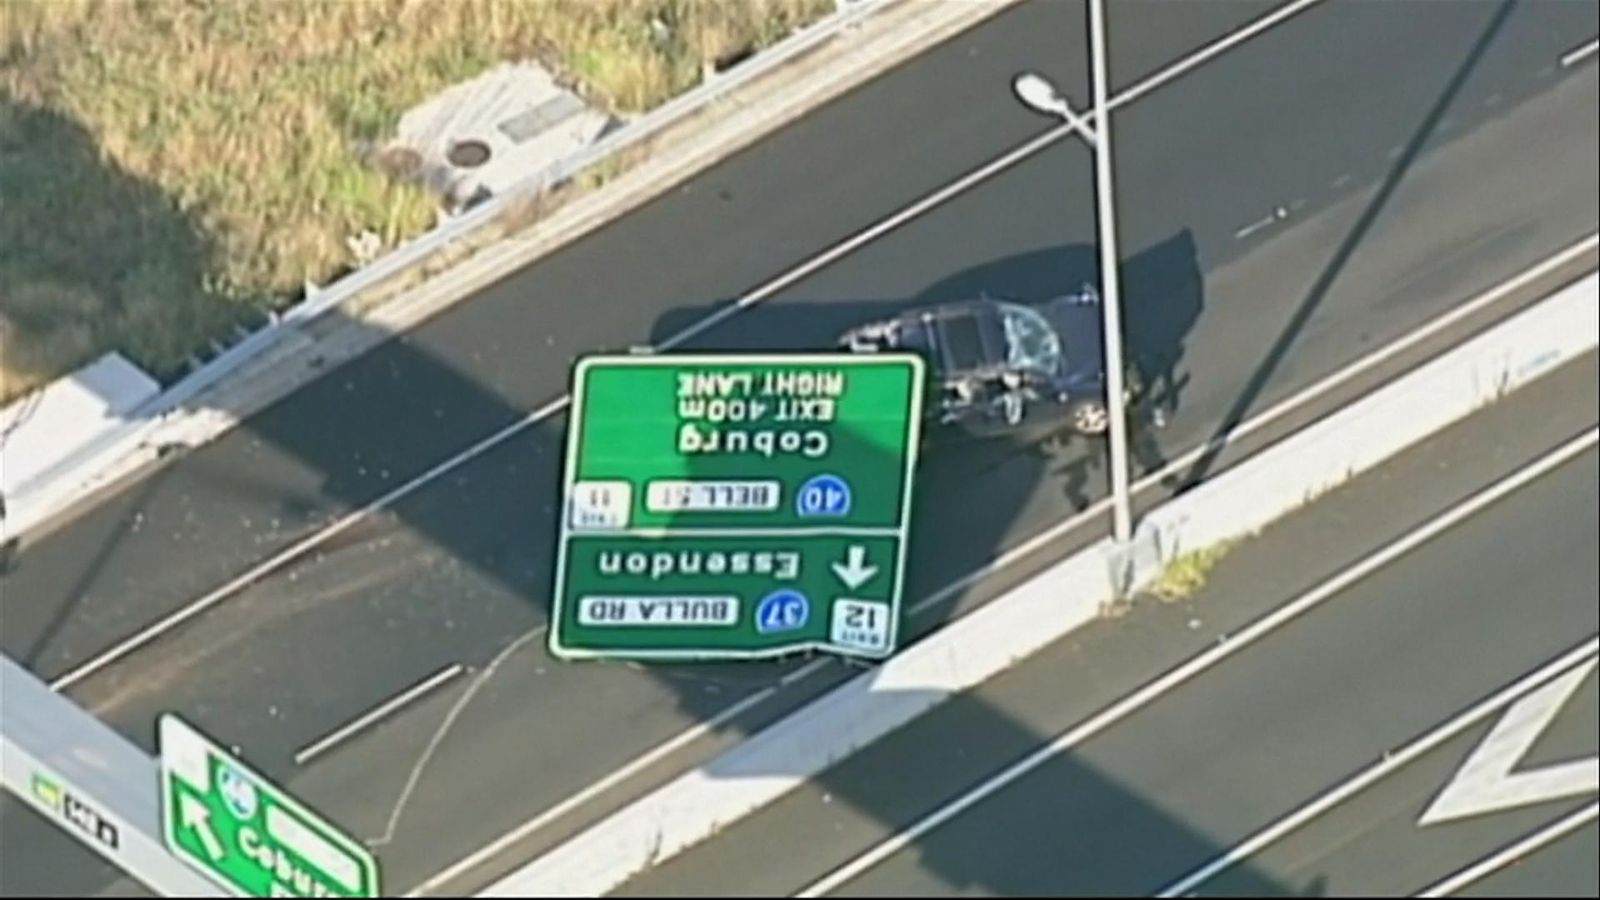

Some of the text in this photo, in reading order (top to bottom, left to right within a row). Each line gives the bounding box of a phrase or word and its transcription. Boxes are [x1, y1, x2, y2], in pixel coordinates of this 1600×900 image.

[677, 371, 843, 396] RIGHT LANE
[678, 398, 836, 421] EXIT 400m
[678, 423, 829, 457] Coburg
[699, 485, 770, 507] BELL
[808, 486, 844, 510] 40
[599, 551, 800, 580] Essendon
[589, 600, 728, 622] BULLA RD
[765, 602, 800, 627] 37
[845, 604, 876, 629] 12
